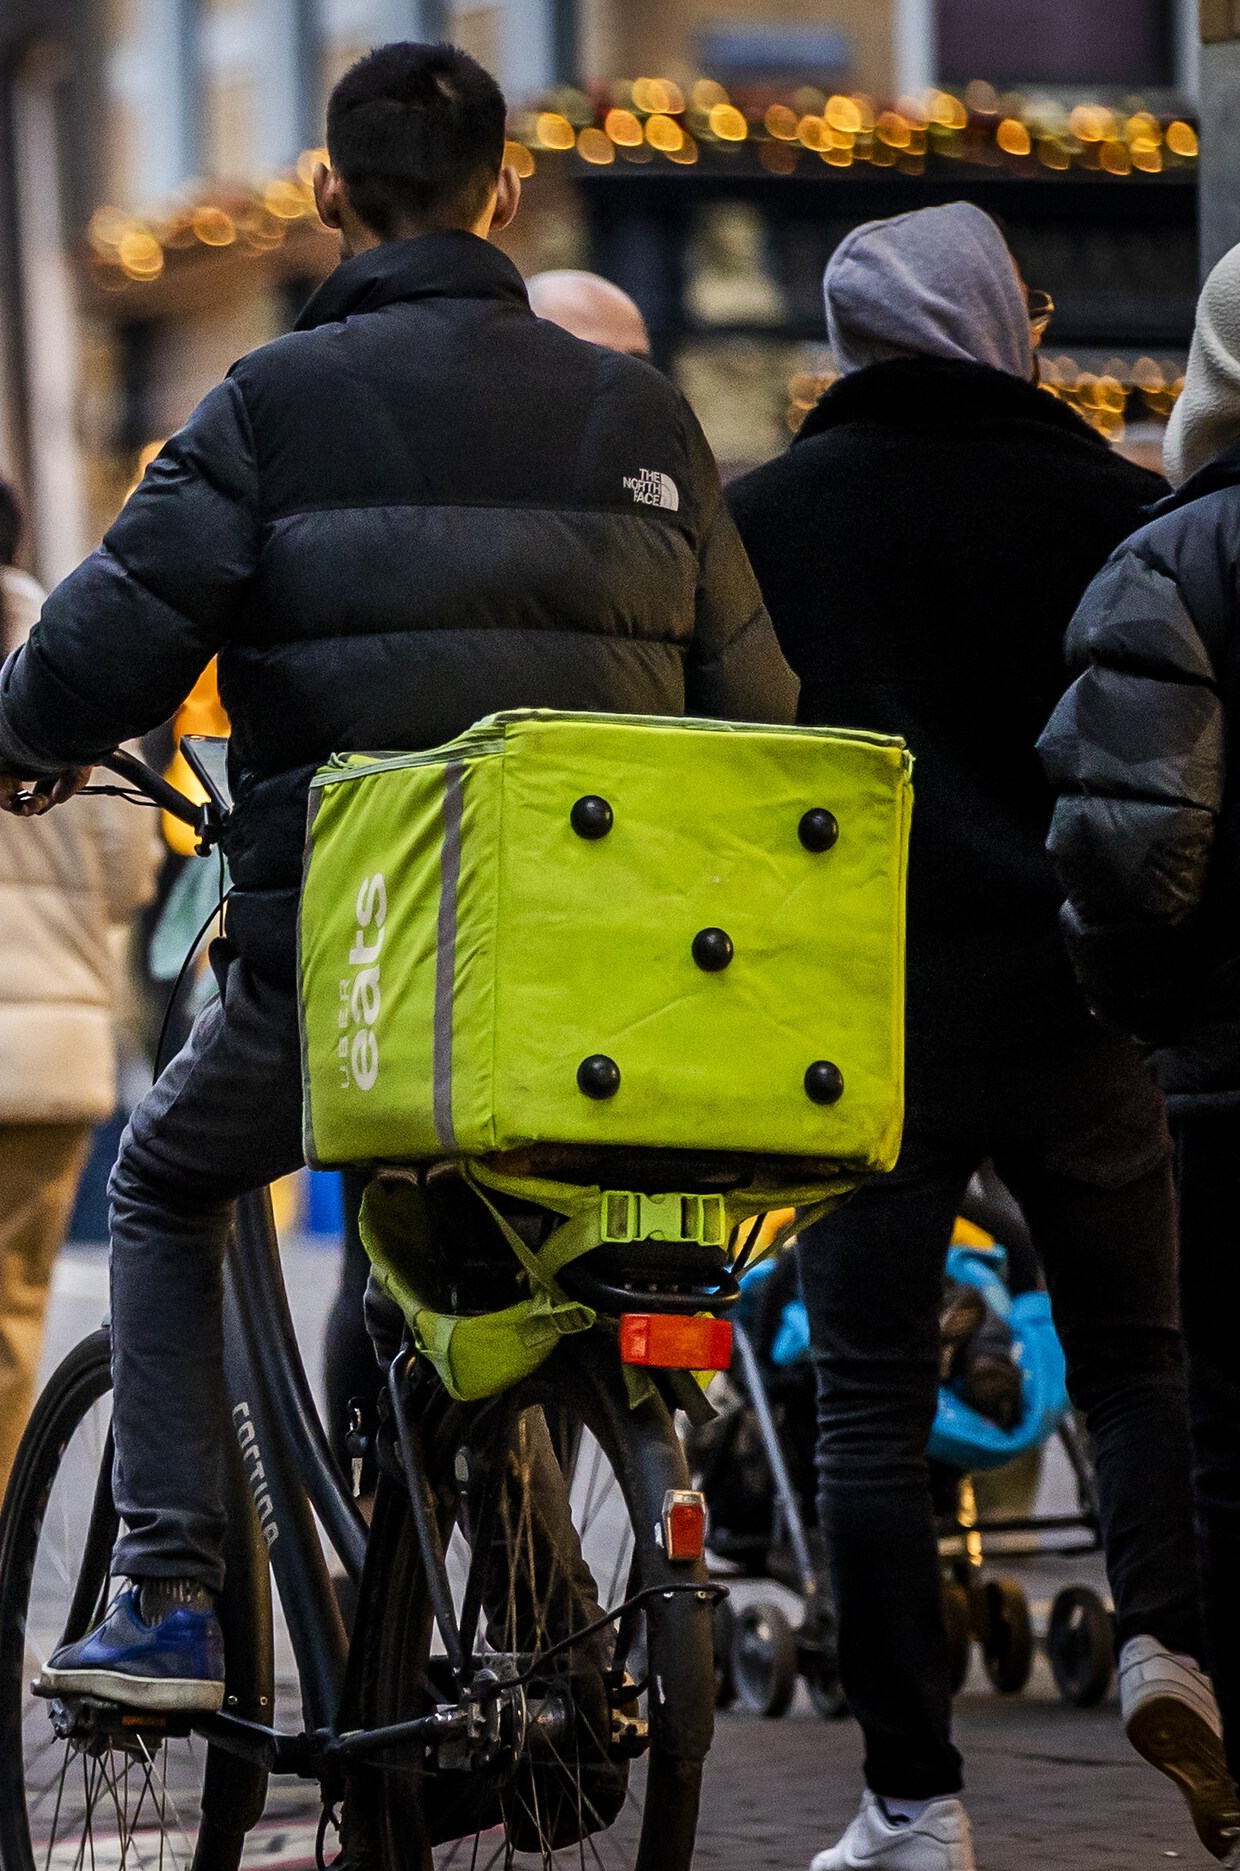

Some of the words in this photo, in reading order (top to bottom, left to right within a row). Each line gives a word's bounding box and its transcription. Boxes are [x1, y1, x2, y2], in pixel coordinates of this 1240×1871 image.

[639, 468, 661, 482] THE
[622, 476, 661, 495] NORTH
[633, 491, 661, 506] FACE
[349, 872, 387, 1091] eats
[338, 978, 352, 1089] UBER
